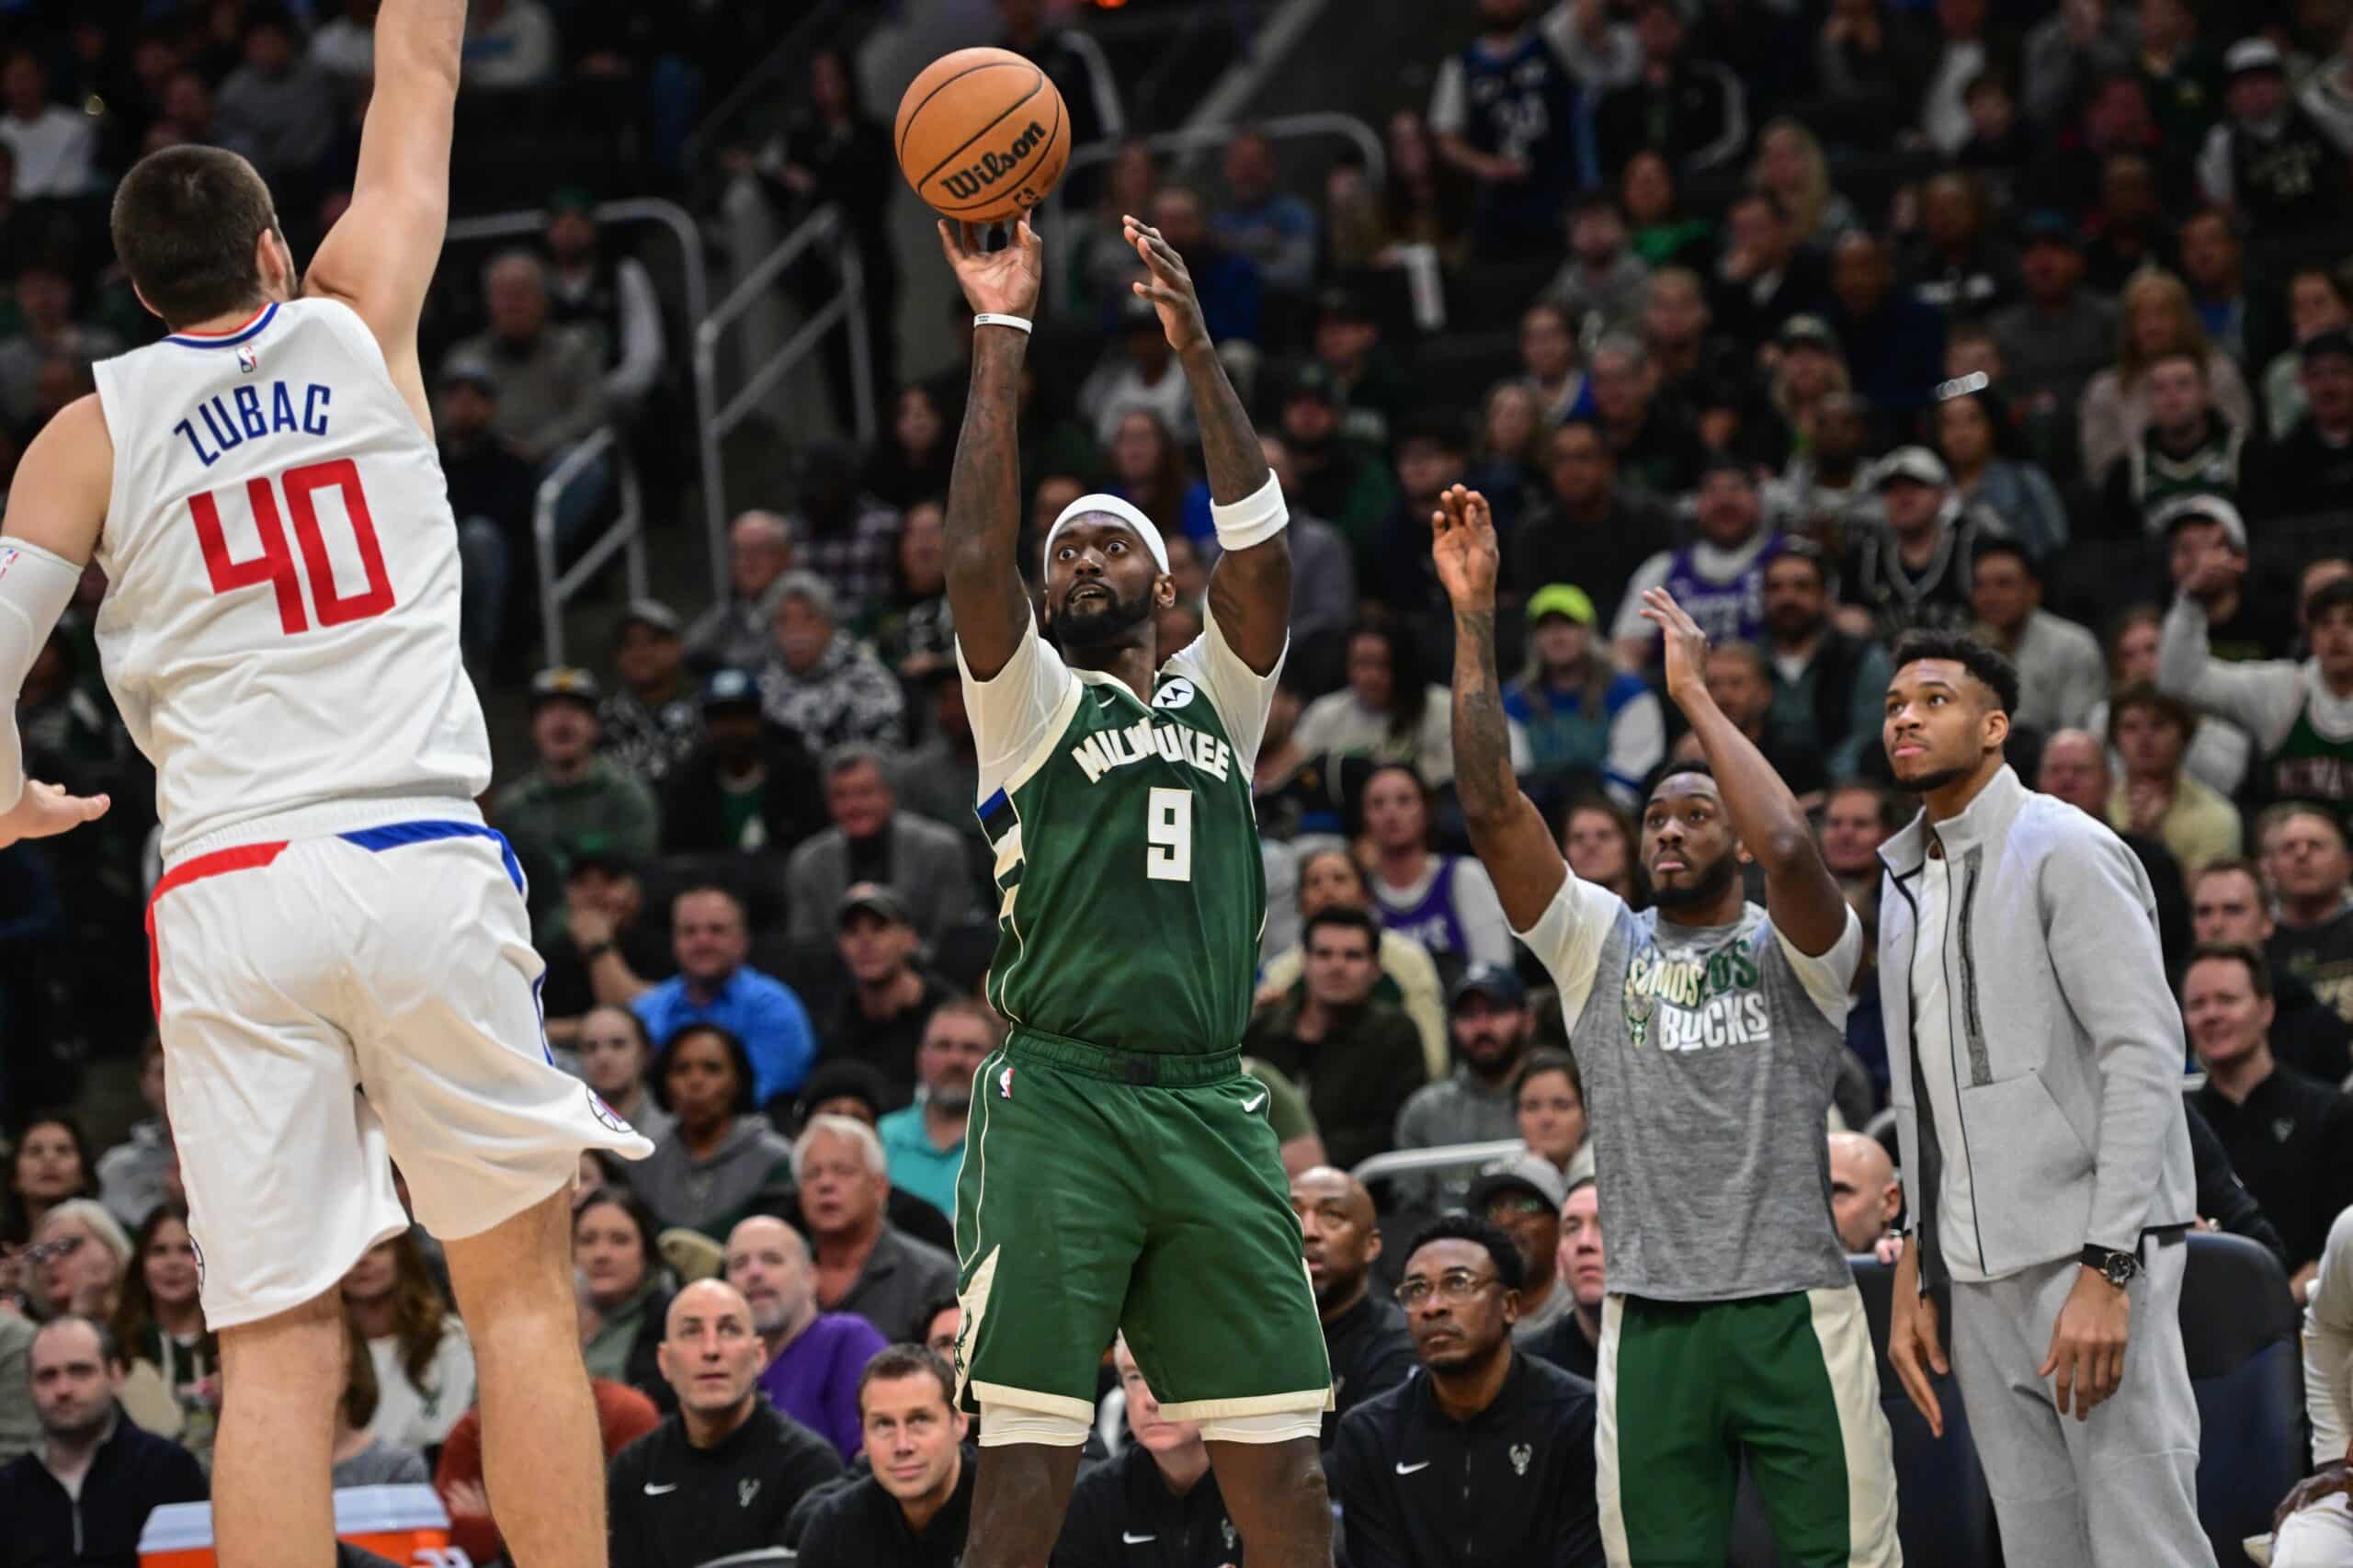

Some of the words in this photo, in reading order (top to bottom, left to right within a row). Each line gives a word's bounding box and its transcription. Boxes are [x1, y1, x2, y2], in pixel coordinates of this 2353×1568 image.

[940, 120, 1046, 200] Wilson
[173, 381, 331, 467] ZUBAC
[187, 458, 396, 635] 40
[1071, 716, 1231, 785] MILWUKEE
[1146, 786, 1193, 882] 9
[1705, 939, 1758, 999] OS
[1659, 992, 1770, 1051] BUCKS
